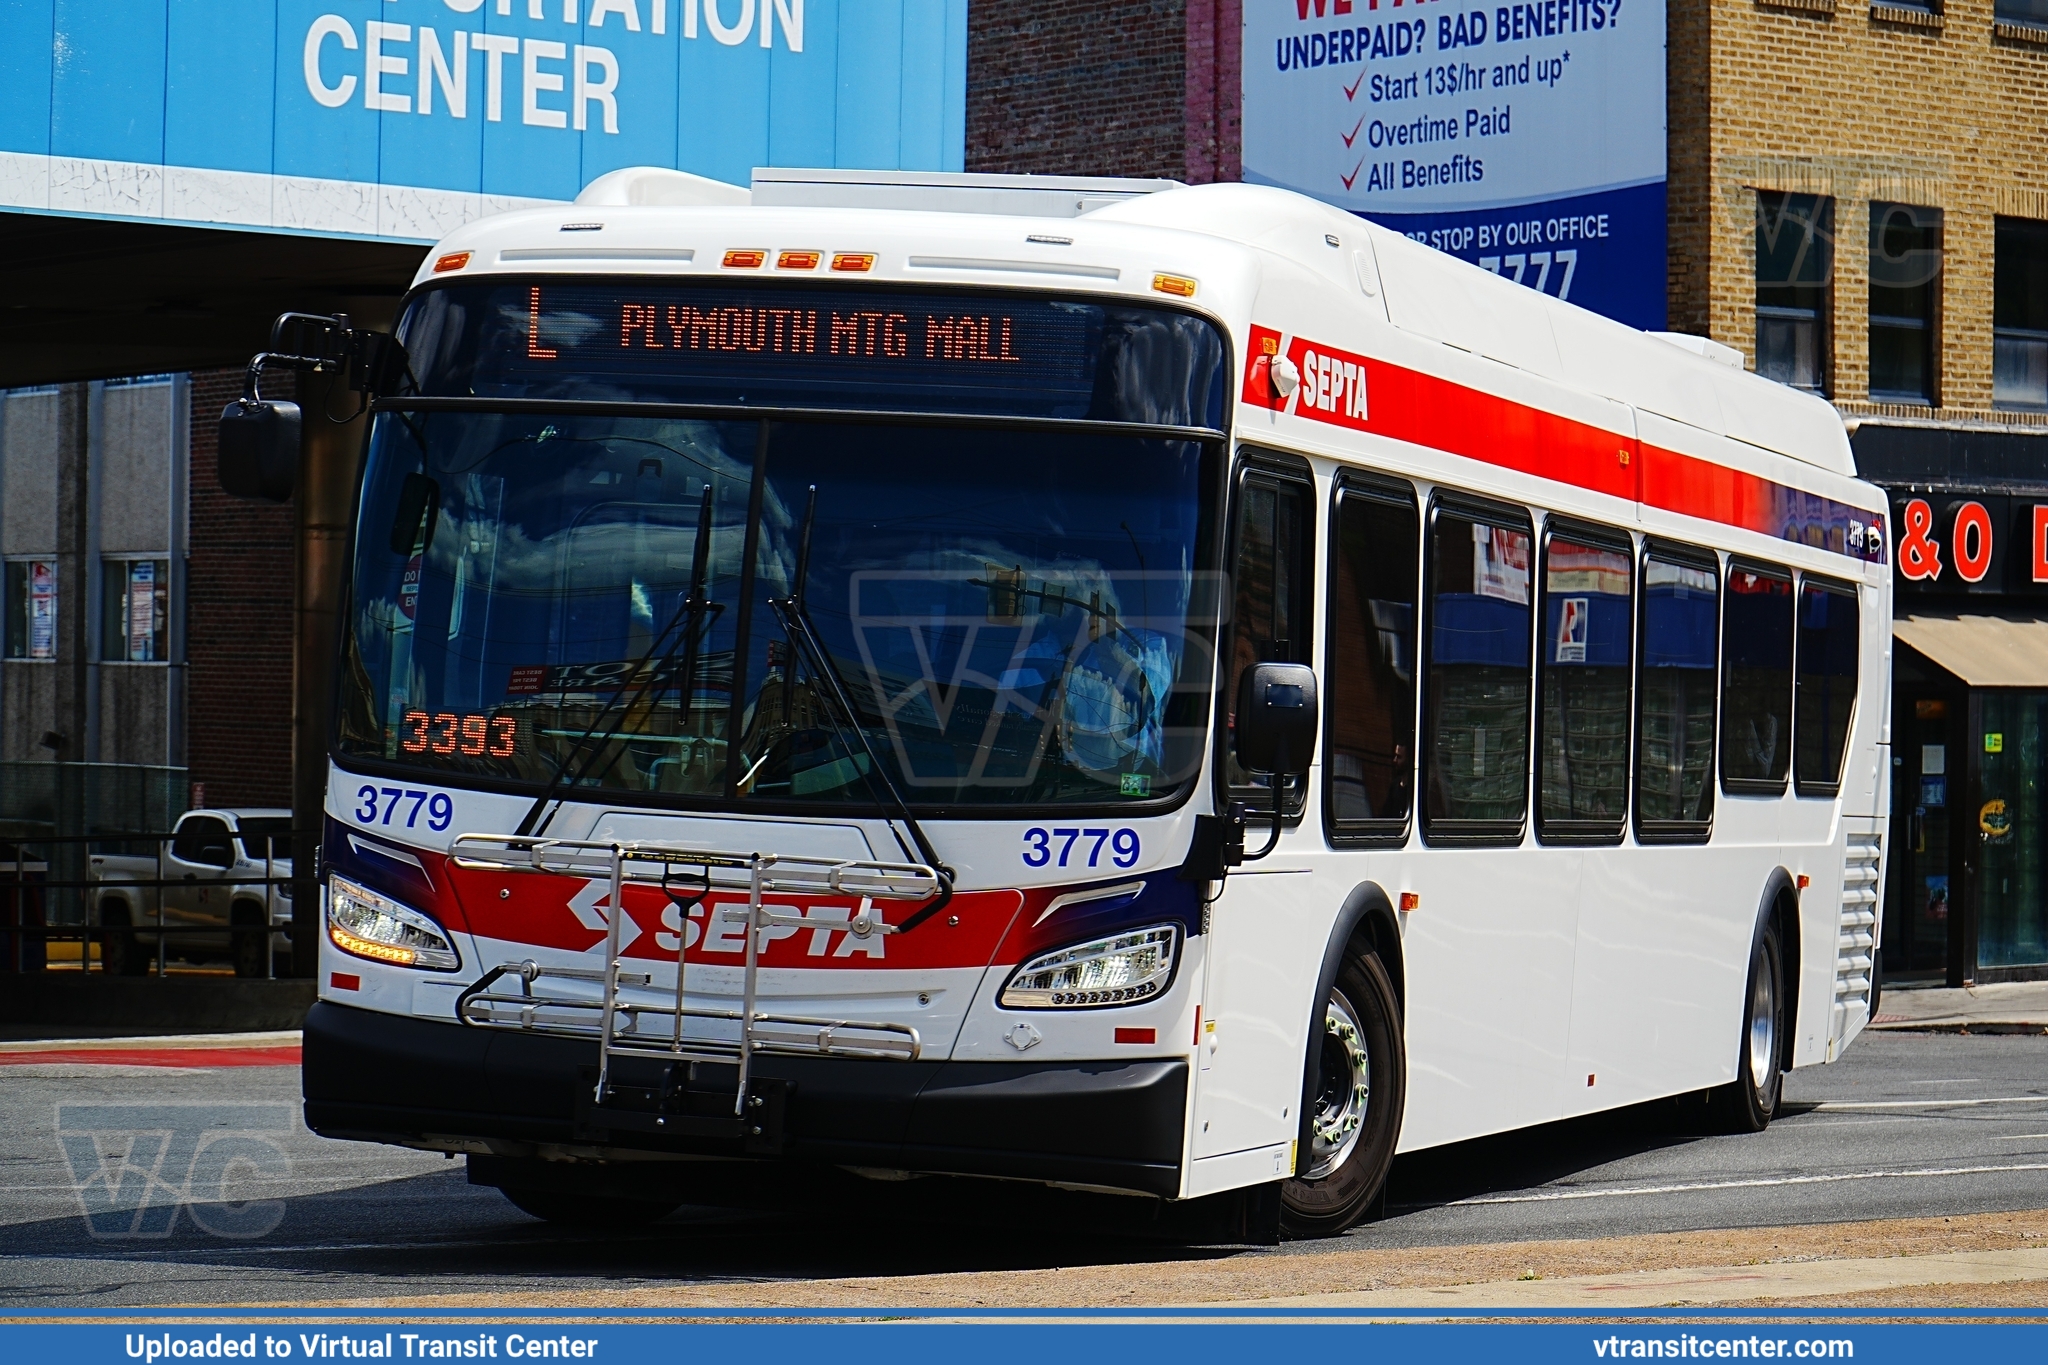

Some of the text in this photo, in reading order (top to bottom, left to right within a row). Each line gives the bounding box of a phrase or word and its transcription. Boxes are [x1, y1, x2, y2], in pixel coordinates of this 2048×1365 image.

[1276, 18, 1426, 71] UNDERPAID?
[1438, 11, 1487, 50] BAD
[1496, 0, 1621, 43] BENEFITS?
[304, 15, 620, 134] CENTER
[1370, 72, 1418, 102] Start
[1425, 62, 1486, 96] 13$/hr
[1492, 55, 1530, 88] and
[1368, 105, 1510, 148] Overtime Paid
[1367, 154, 1484, 192] All Benefits
[1431, 226, 1474, 251] STOP
[1478, 224, 1502, 248] BY
[1506, 220, 1542, 246] OUR
[1546, 214, 1609, 242] OFFICE
[528, 286, 1020, 361] L PLYMOUTH MTG MALL
[1303, 349, 1369, 421] SEPTA
[1899, 499, 1943, 582] &
[1953, 501, 1993, 583] O
[403, 710, 516, 757] 3393
[355, 784, 454, 832] 3779
[1021, 827, 1141, 868] 3779
[654, 901, 886, 959] SEPTA
